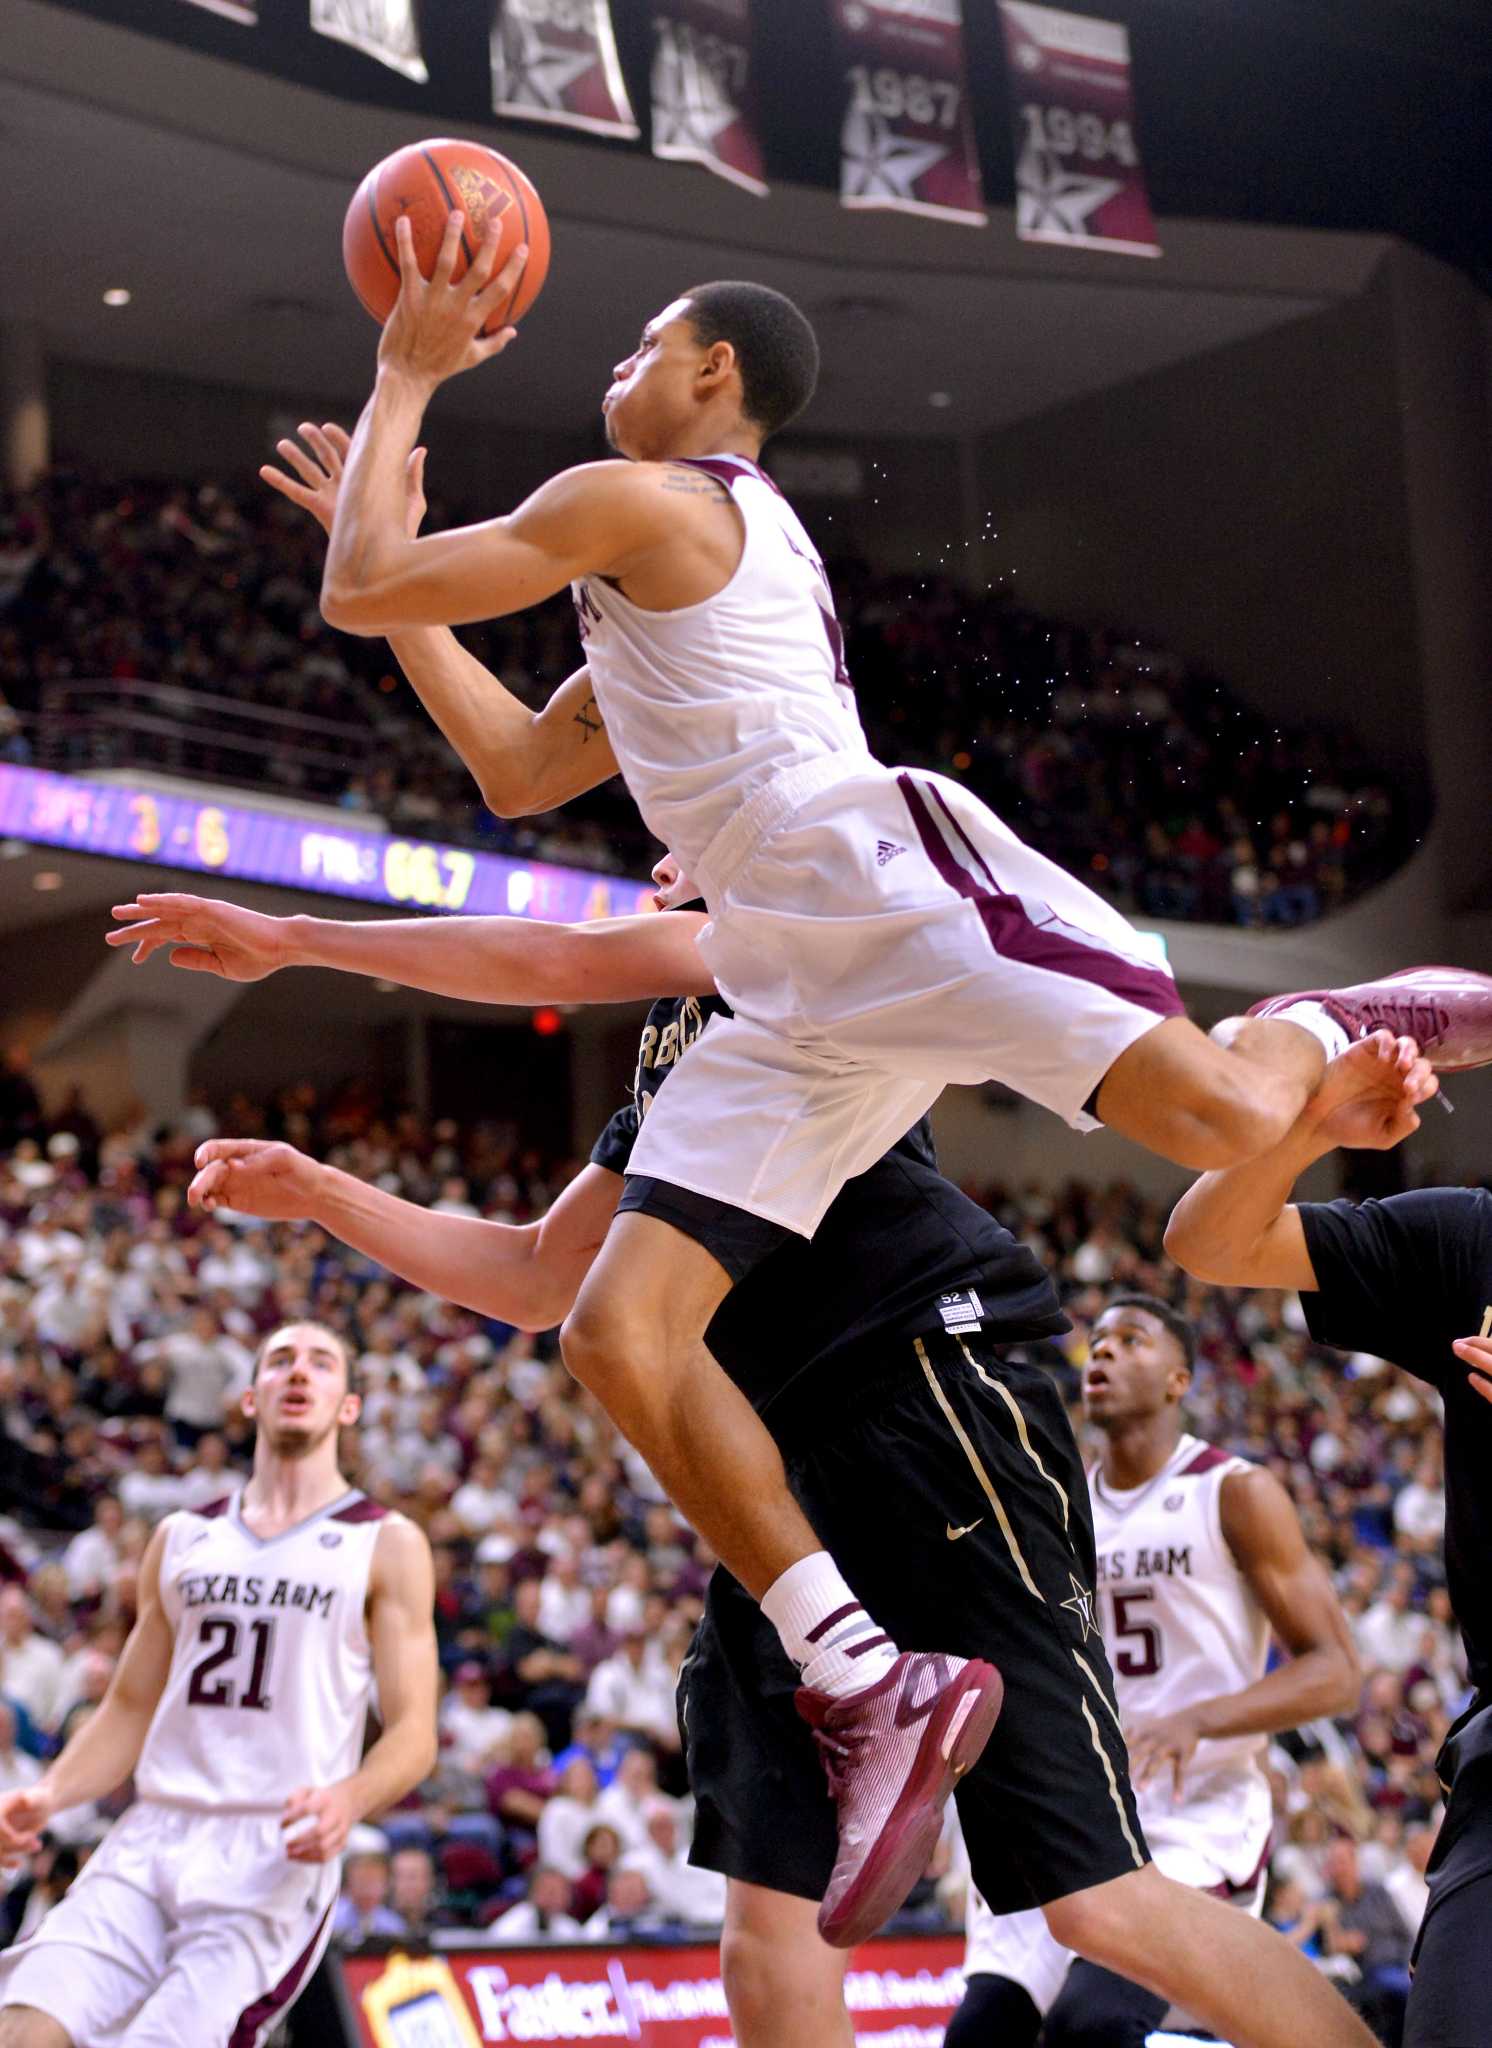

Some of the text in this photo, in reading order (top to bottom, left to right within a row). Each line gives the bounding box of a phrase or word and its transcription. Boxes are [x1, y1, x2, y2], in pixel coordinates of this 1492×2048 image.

[849, 64, 961, 129] 1987
[1022, 103, 1139, 166] 1994
[941, 1292, 962, 1304] 52
[187, 1614, 277, 1711] 21
[1110, 1584, 1164, 1680] 5
